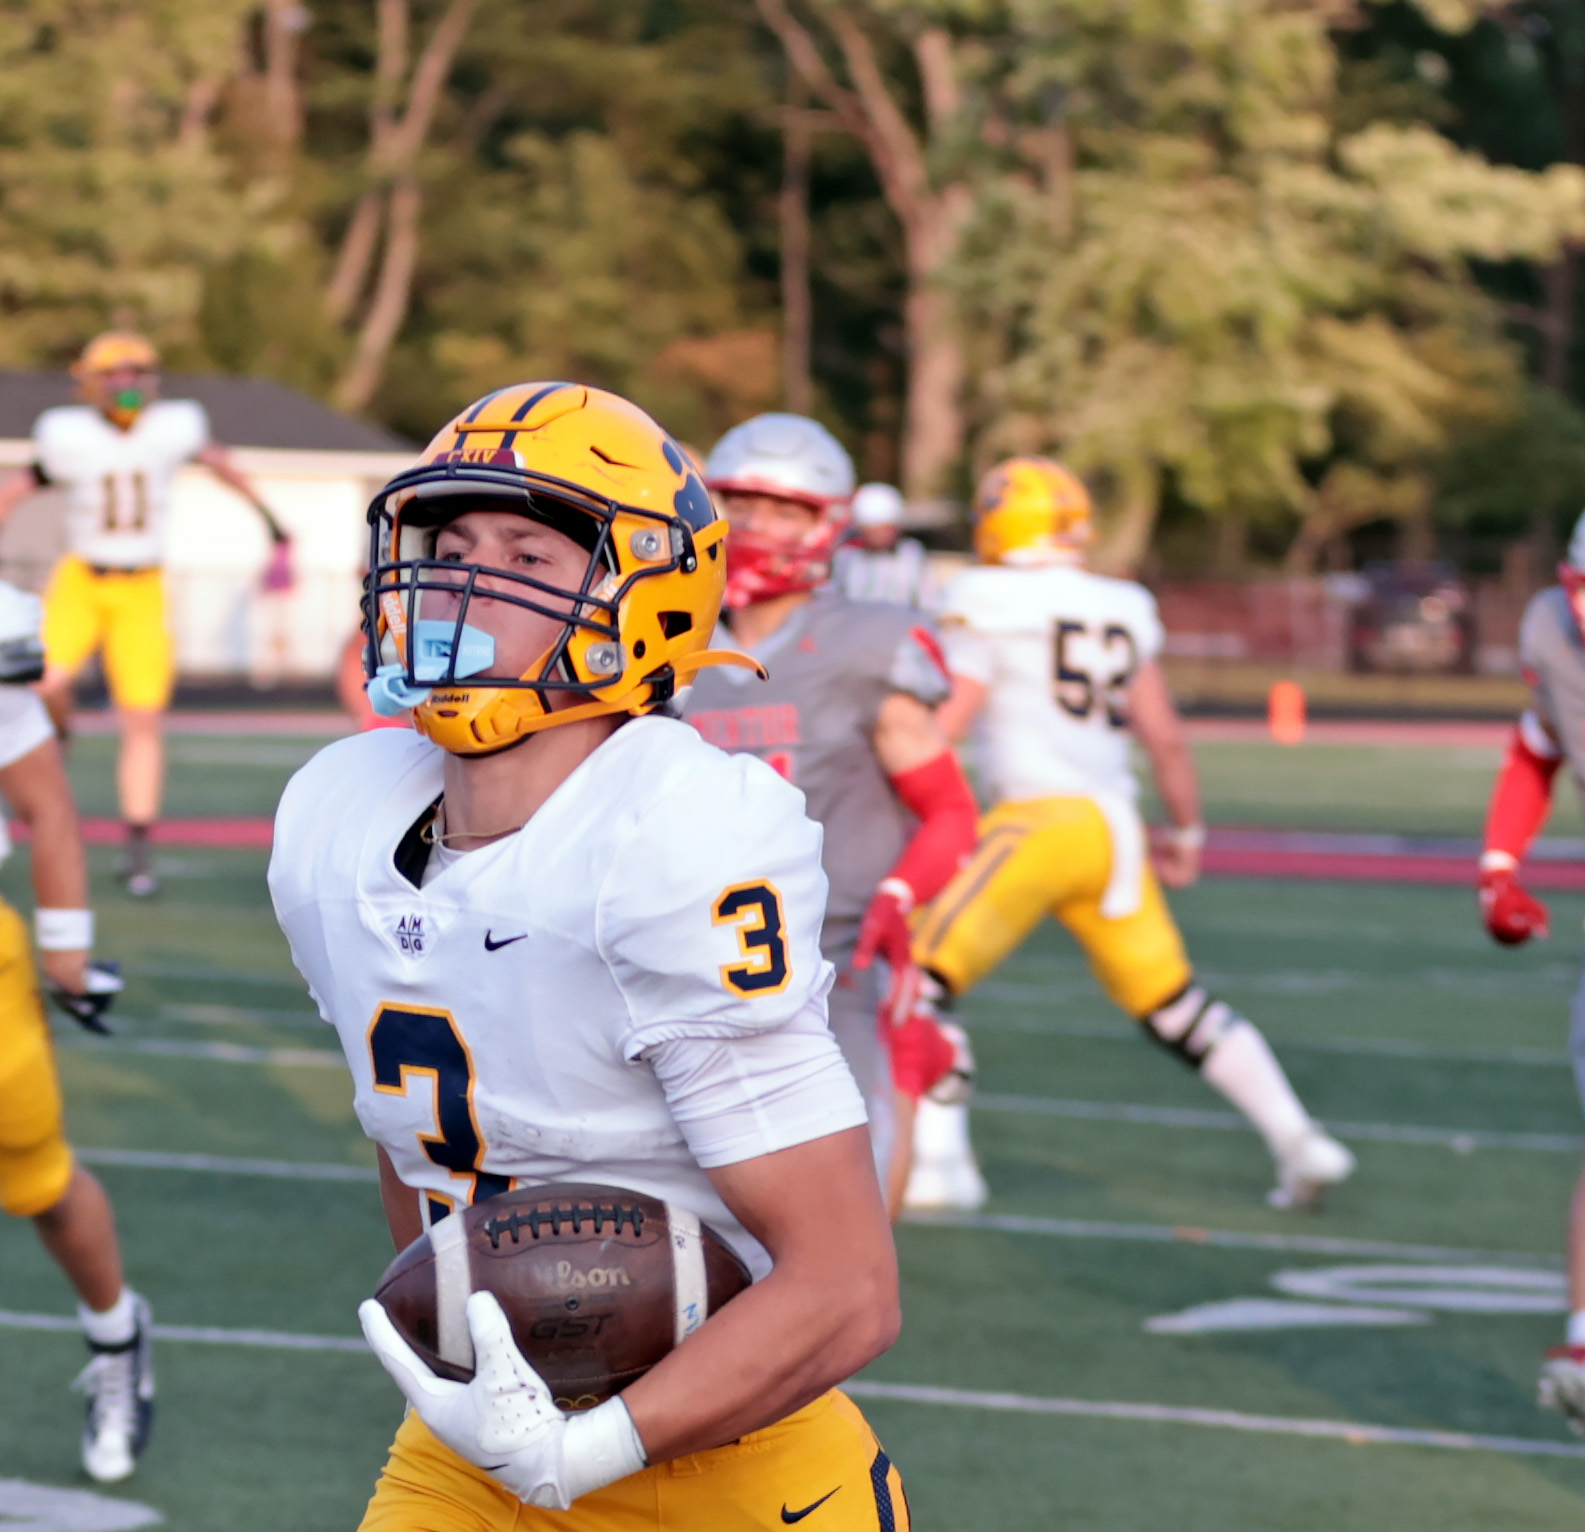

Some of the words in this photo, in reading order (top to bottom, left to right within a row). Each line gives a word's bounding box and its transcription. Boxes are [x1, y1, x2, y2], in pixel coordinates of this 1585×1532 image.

[102, 471, 148, 533] 11
[1052, 618, 1138, 730] 52
[710, 878, 793, 1001] 3
[366, 1000, 519, 1226] 3
[530, 1313, 615, 1340] GST
